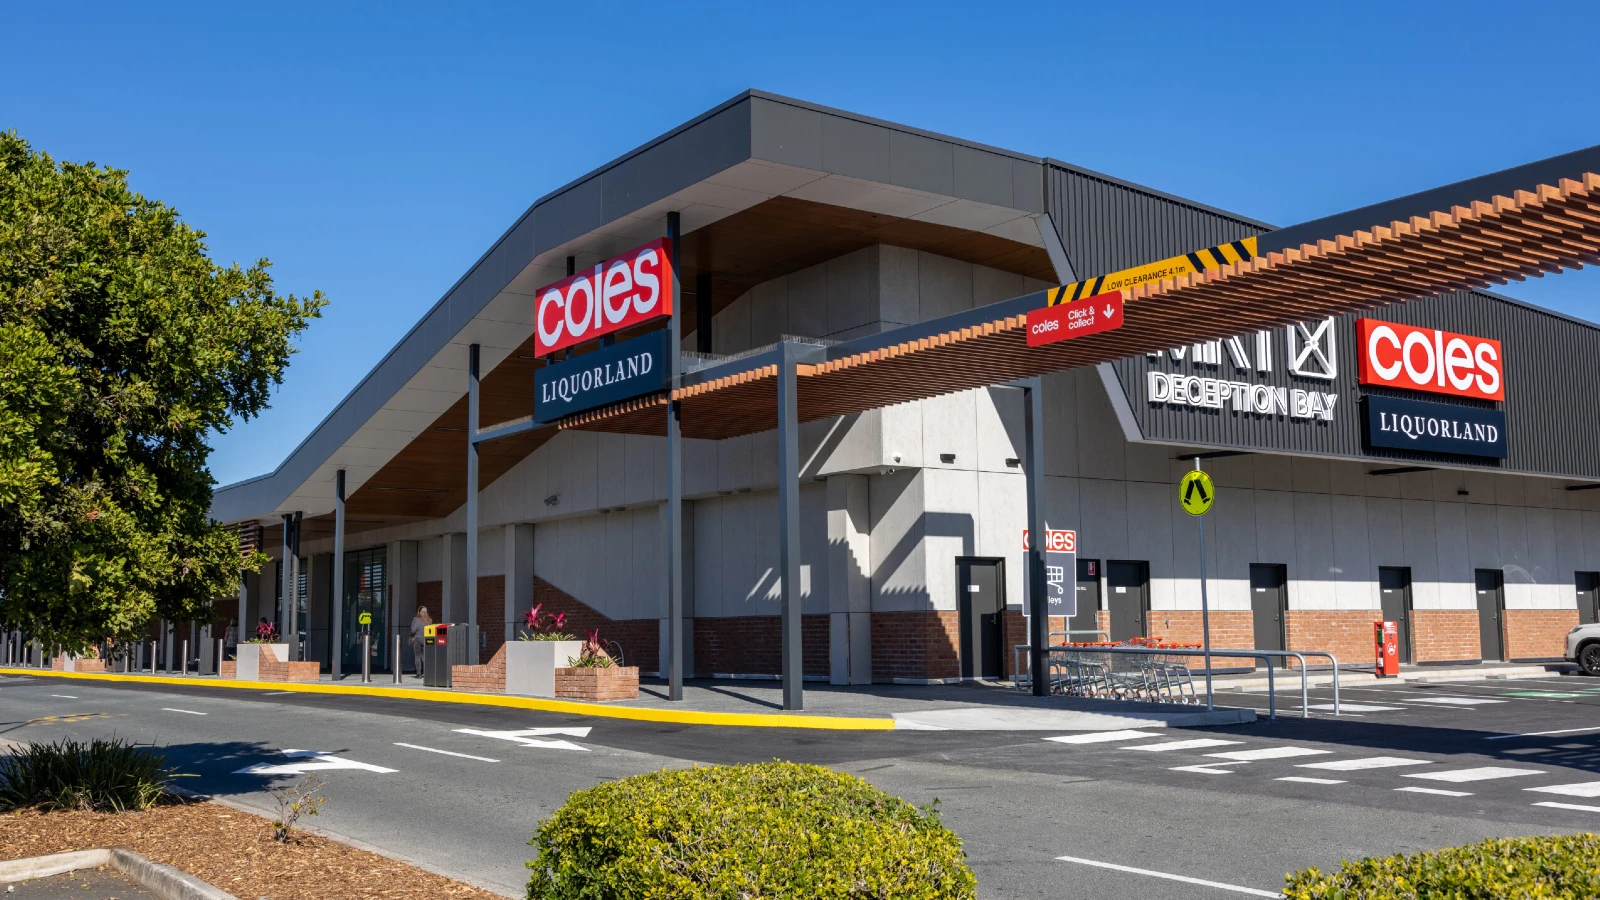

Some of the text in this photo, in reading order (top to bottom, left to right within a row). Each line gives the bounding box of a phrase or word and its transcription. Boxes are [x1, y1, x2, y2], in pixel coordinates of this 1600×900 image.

[1107, 265, 1186, 291] LOW CLEARANCE 4.1m
[538, 248, 659, 347] coles
[1031, 319, 1059, 335] coles
[1067, 306, 1095, 320] Click &
[1068, 317, 1095, 330] collect
[1368, 325, 1498, 395] coles
[542, 352, 653, 403] LIQUORLAND
[1147, 371, 1338, 421] DECEPTION BAY
[1380, 412, 1498, 444] LIQUORLAND
[1024, 531, 1073, 550] les
